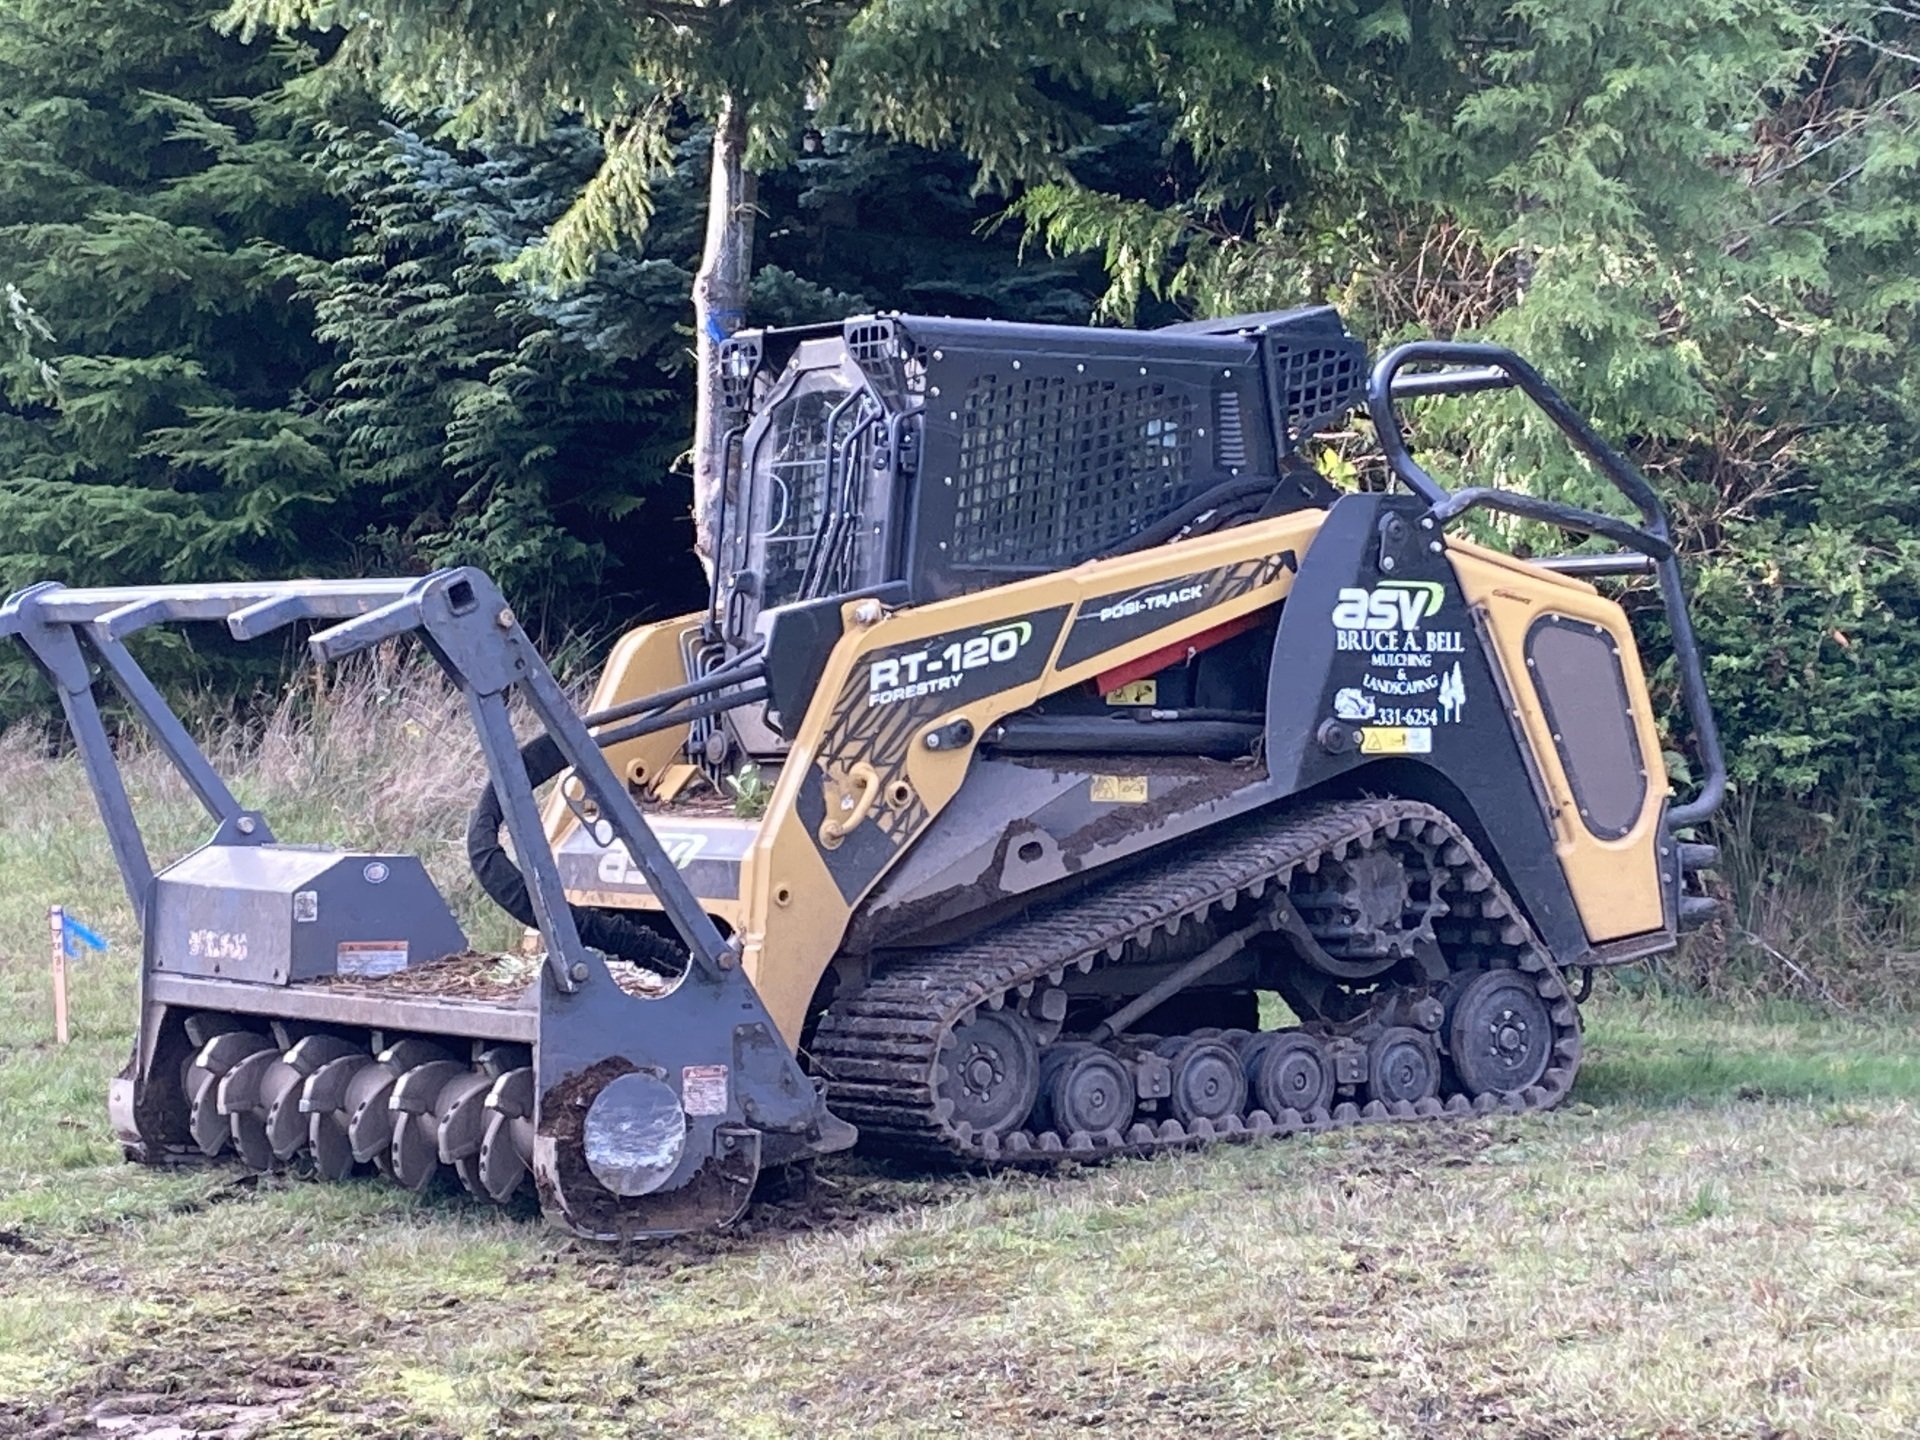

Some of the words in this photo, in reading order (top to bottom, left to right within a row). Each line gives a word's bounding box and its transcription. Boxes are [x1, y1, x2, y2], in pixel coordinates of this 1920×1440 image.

[1100, 584, 1203, 622] POSI-TRACK
[1336, 630, 1399, 651] BRUCE
[1402, 632, 1422, 652] A.
[1426, 632, 1465, 652] BELL
[869, 629, 1019, 691] RT-120
[1371, 653, 1432, 667] MULCHING
[1362, 673, 1438, 695] LANDSCAPING
[1396, 668, 1407, 680] &
[868, 672, 963, 707] FORESTRY
